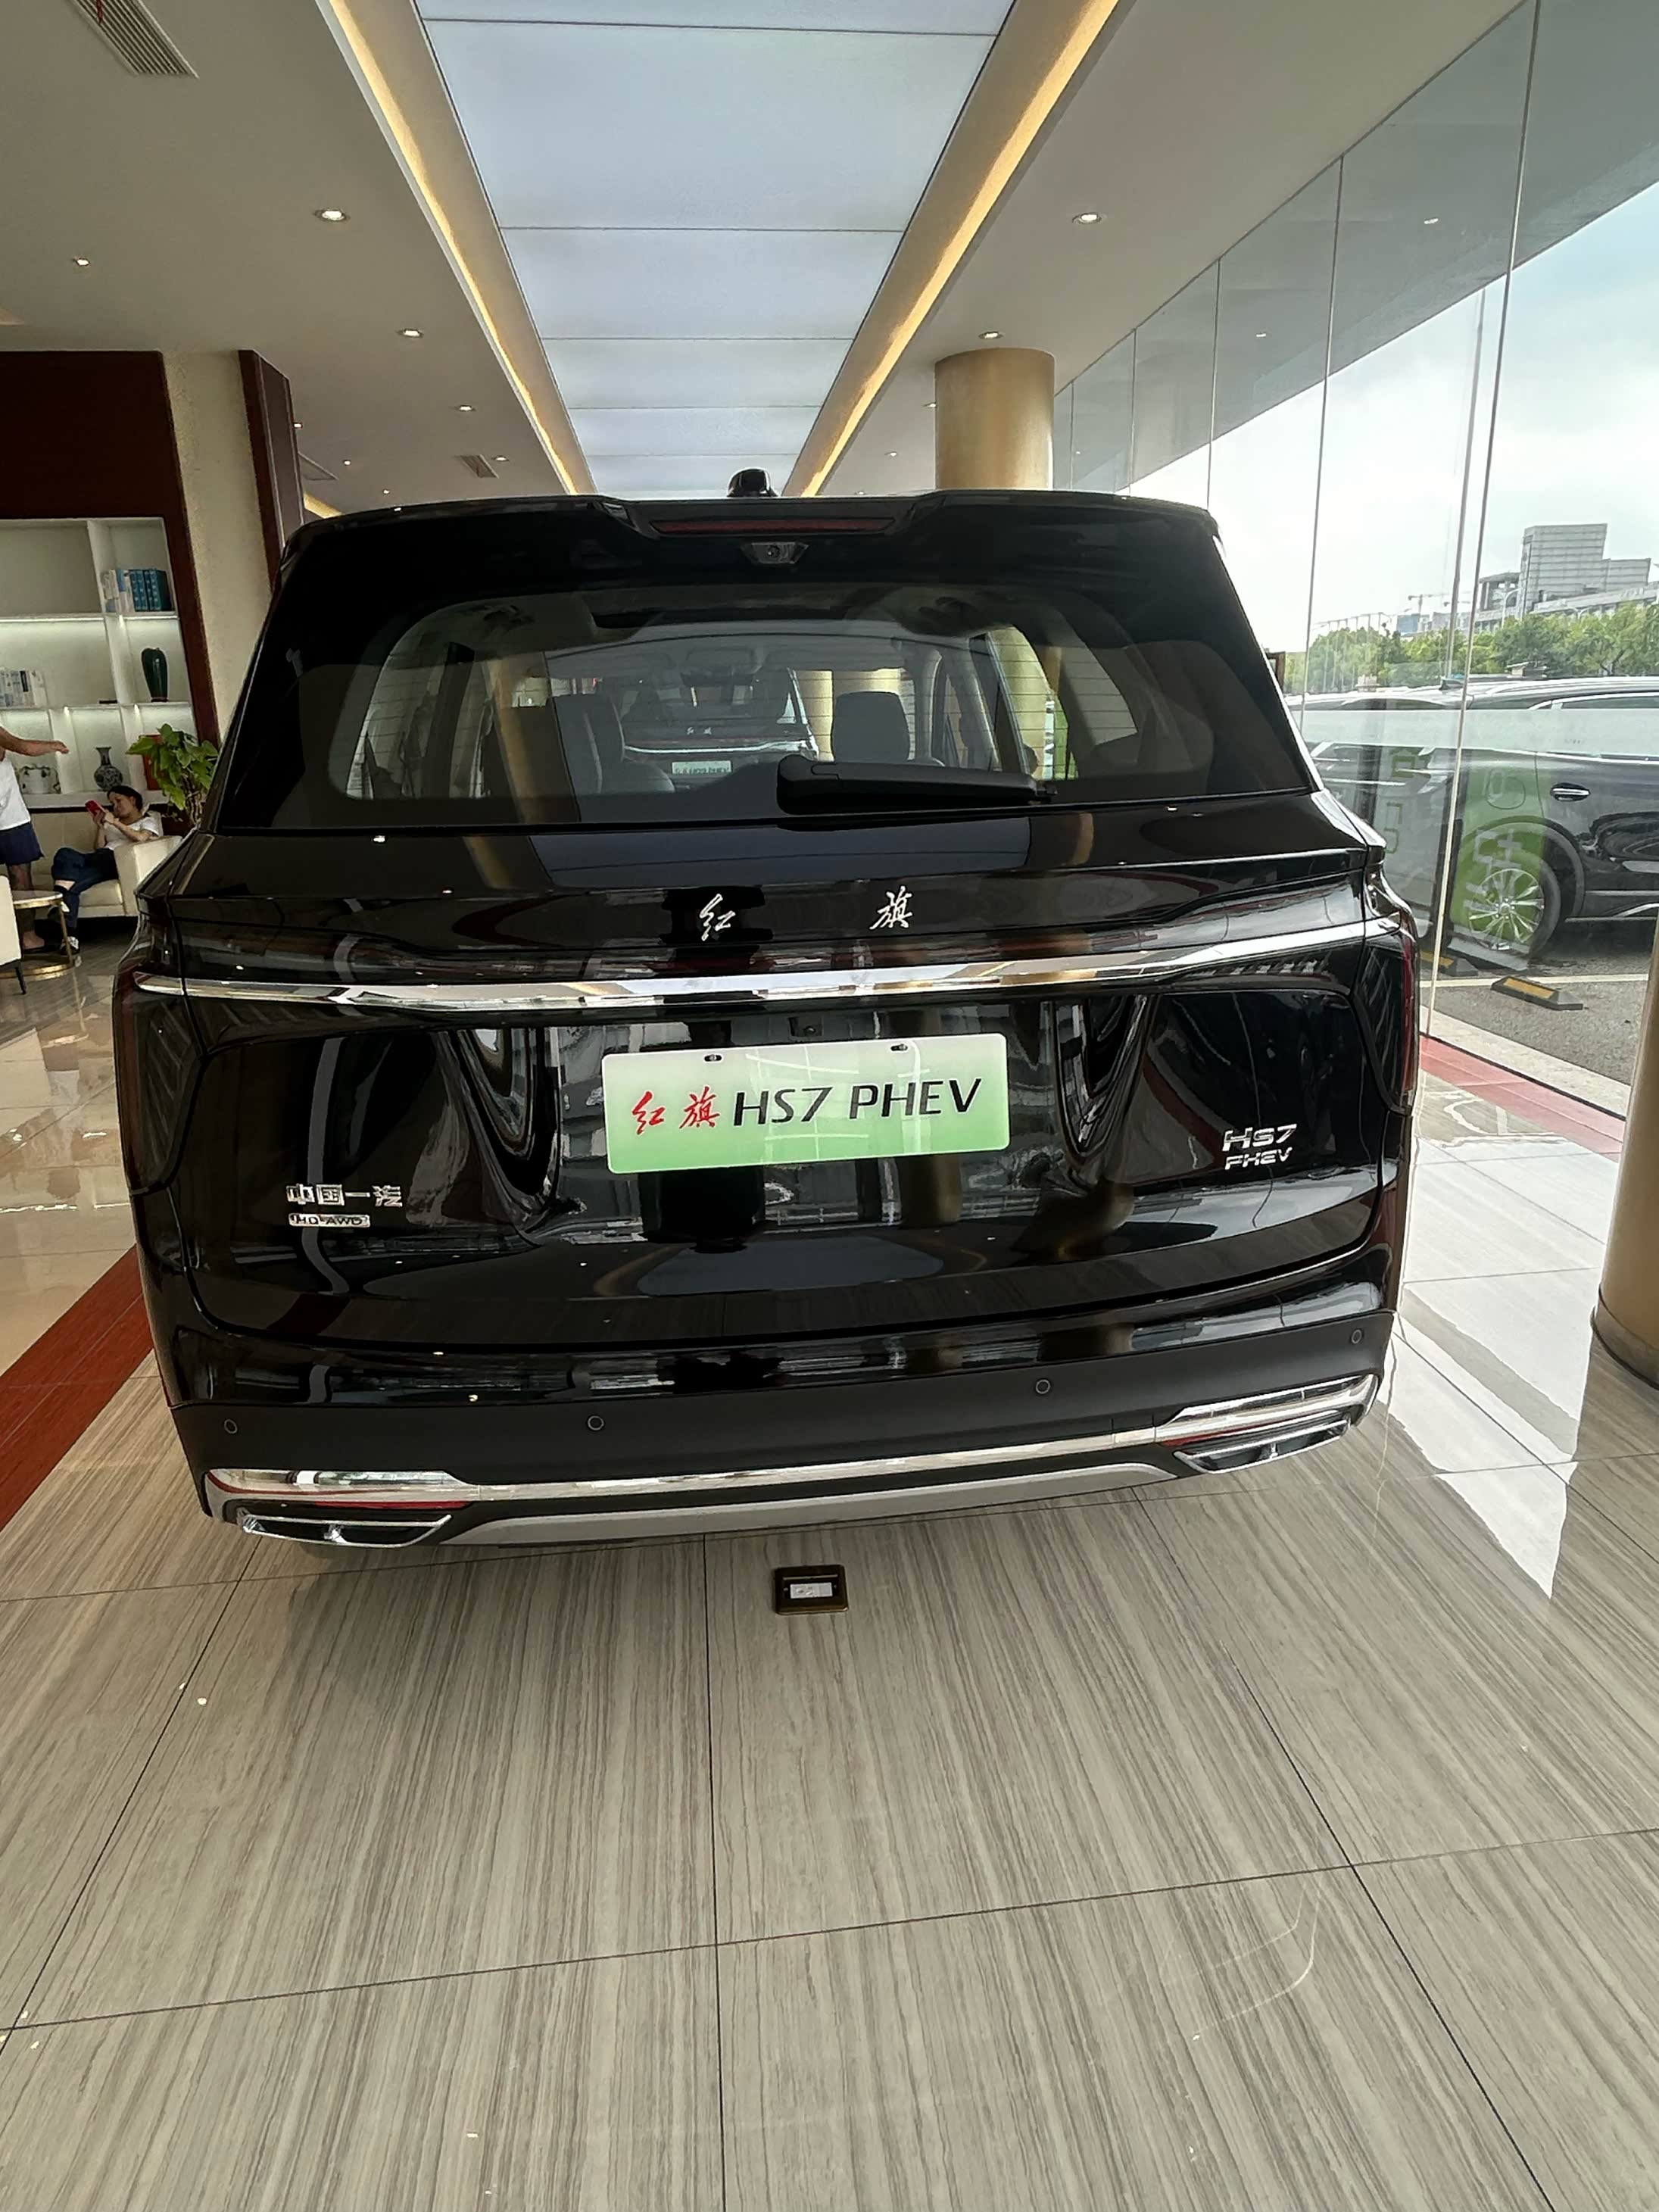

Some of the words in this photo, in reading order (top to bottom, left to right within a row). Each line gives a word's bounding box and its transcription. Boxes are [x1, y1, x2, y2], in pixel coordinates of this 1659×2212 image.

[631, 1085, 721, 1135] 红旗
[733, 1087, 833, 1127] HS7
[849, 1078, 982, 1119] PHEV
[1222, 1123, 1297, 1151] HS7
[1224, 1147, 1293, 1170] PHEV
[286, 1184, 403, 1207] 中国一汽
